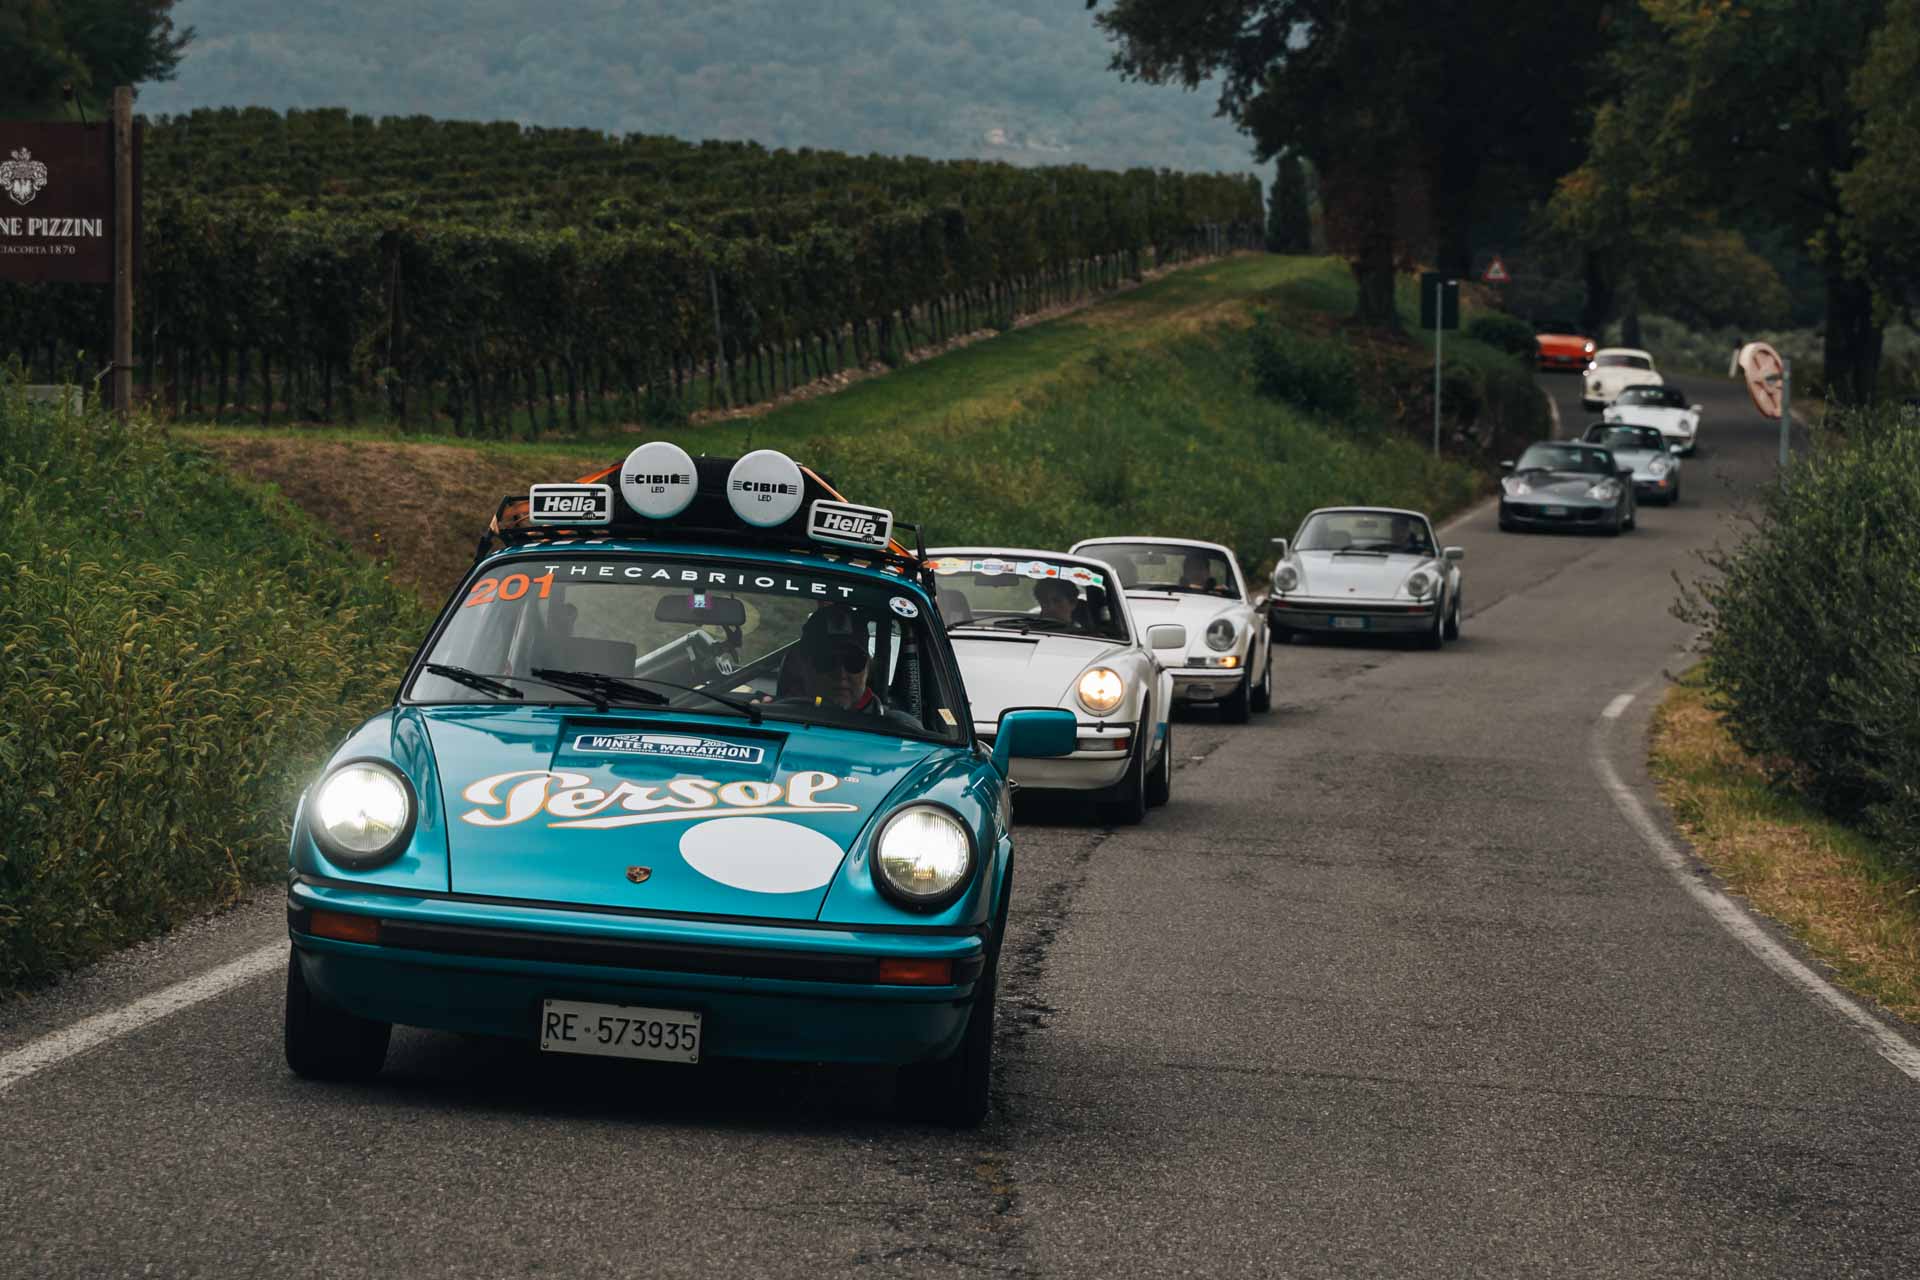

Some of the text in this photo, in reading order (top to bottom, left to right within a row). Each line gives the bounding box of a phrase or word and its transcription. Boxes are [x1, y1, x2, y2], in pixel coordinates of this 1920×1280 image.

[28, 217, 103, 237] PIZZINI
[50, 245, 76, 255] 1870
[651, 486, 665, 494] LED
[757, 494, 772, 502] LED
[543, 496, 597, 513] Hella
[823, 513, 877, 535] Hella
[465, 572, 555, 608] 201
[592, 736, 655, 750] WINTER
[660, 744, 751, 758] MARATHON
[461, 770, 858, 828] Persol
[545, 1012, 698, 1052] RE 573935
